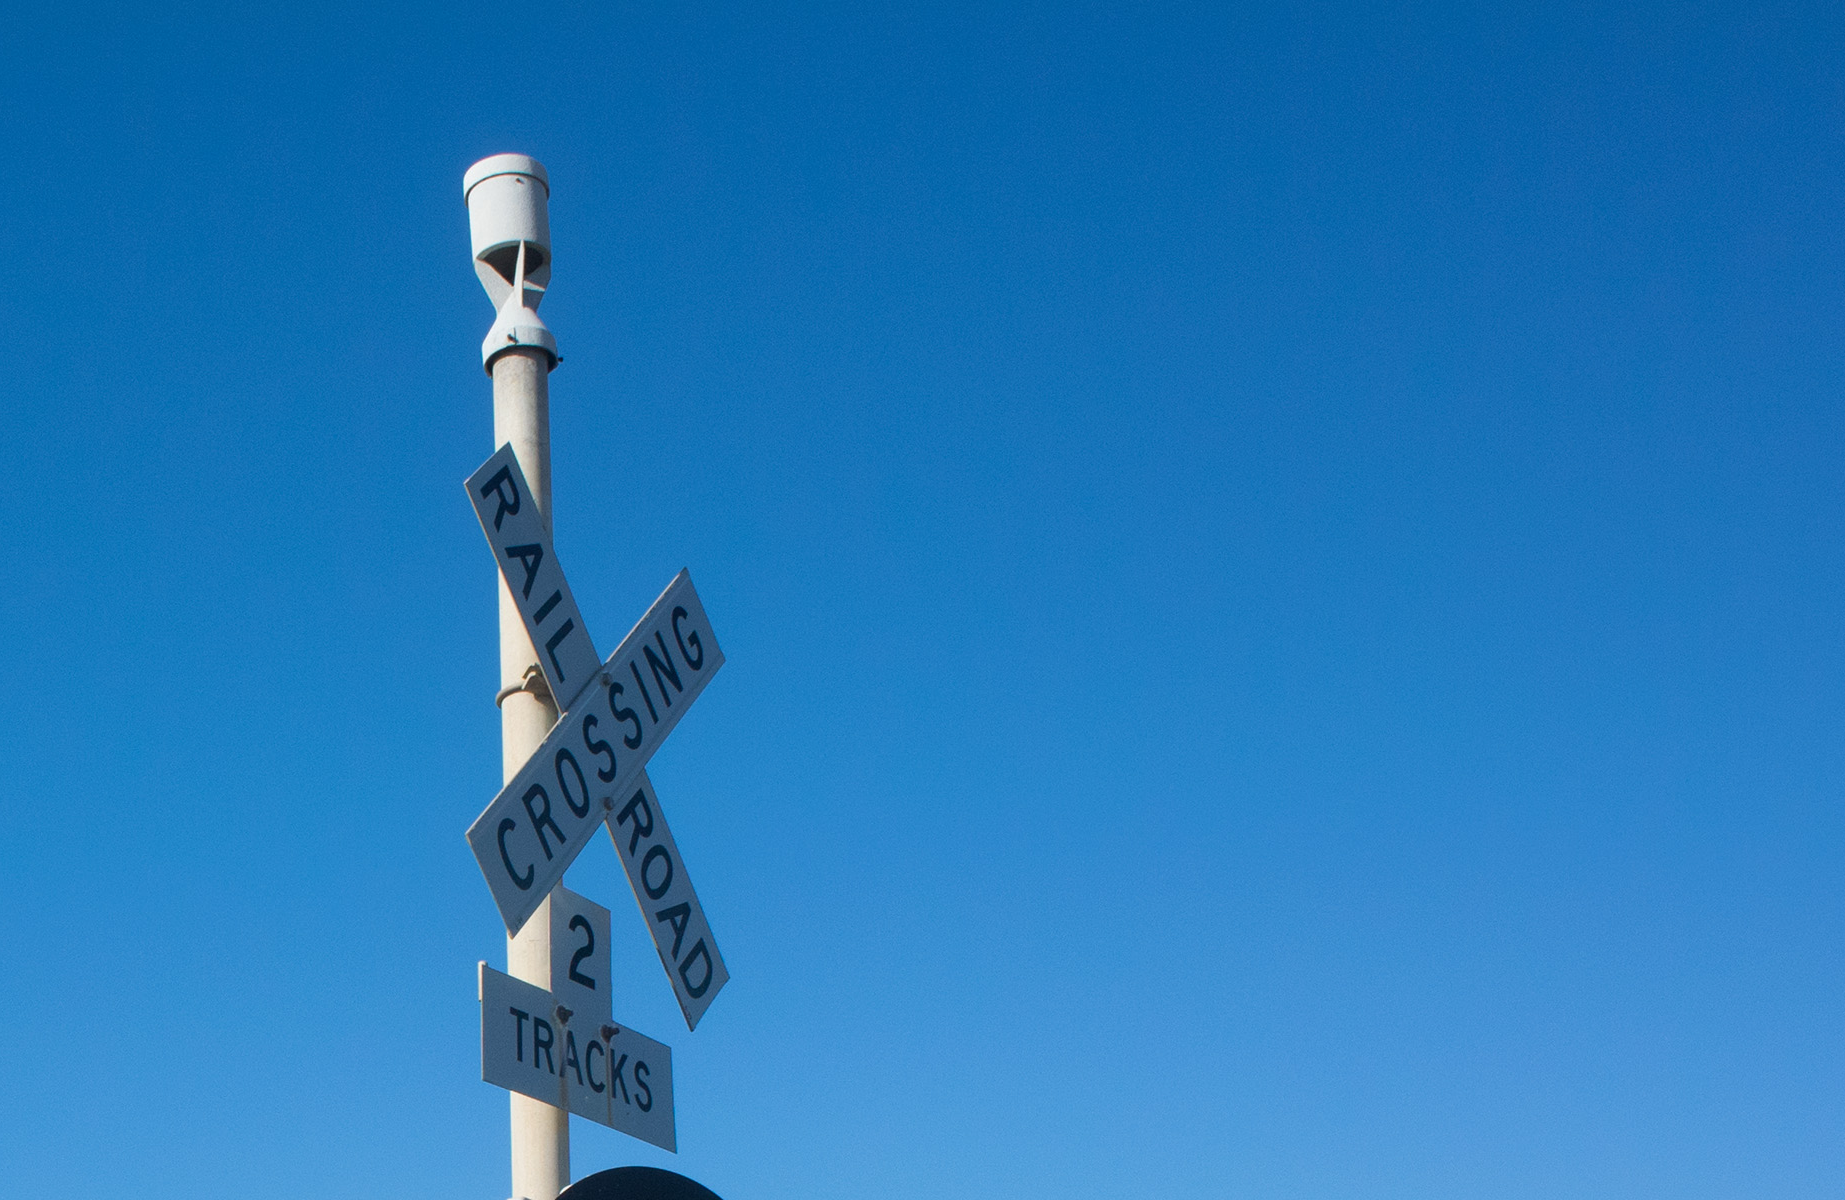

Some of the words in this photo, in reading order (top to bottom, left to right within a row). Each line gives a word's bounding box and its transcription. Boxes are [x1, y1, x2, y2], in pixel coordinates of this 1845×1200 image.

[480, 464, 574, 684] RAIL
[497, 605, 704, 891] CROSSING
[568, 914, 596, 990] 2
[617, 787, 713, 999] ROAD
[509, 1006, 653, 1113] TRACKS
